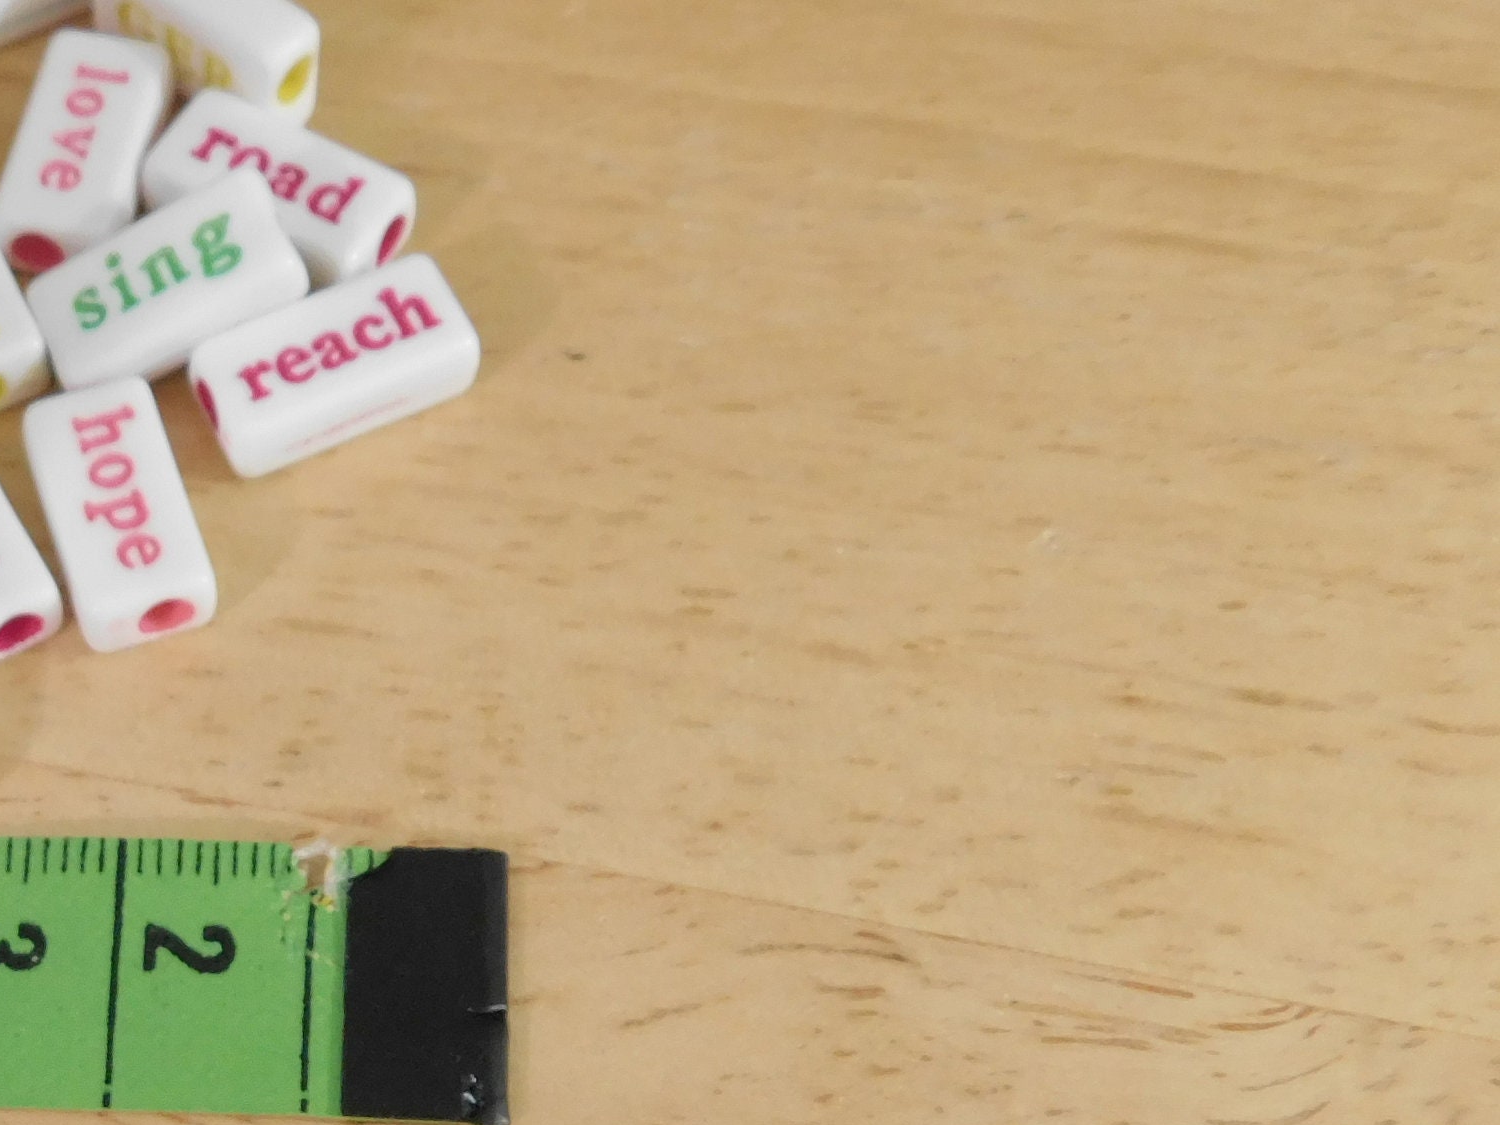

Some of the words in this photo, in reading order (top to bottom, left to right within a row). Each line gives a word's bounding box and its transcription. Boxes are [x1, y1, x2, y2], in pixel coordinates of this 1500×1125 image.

[39, 64, 130, 192] love
[71, 211, 243, 332] sing
[238, 287, 441, 402] reach
[71, 402, 163, 571] hope
[142, 923, 237, 975] 2
